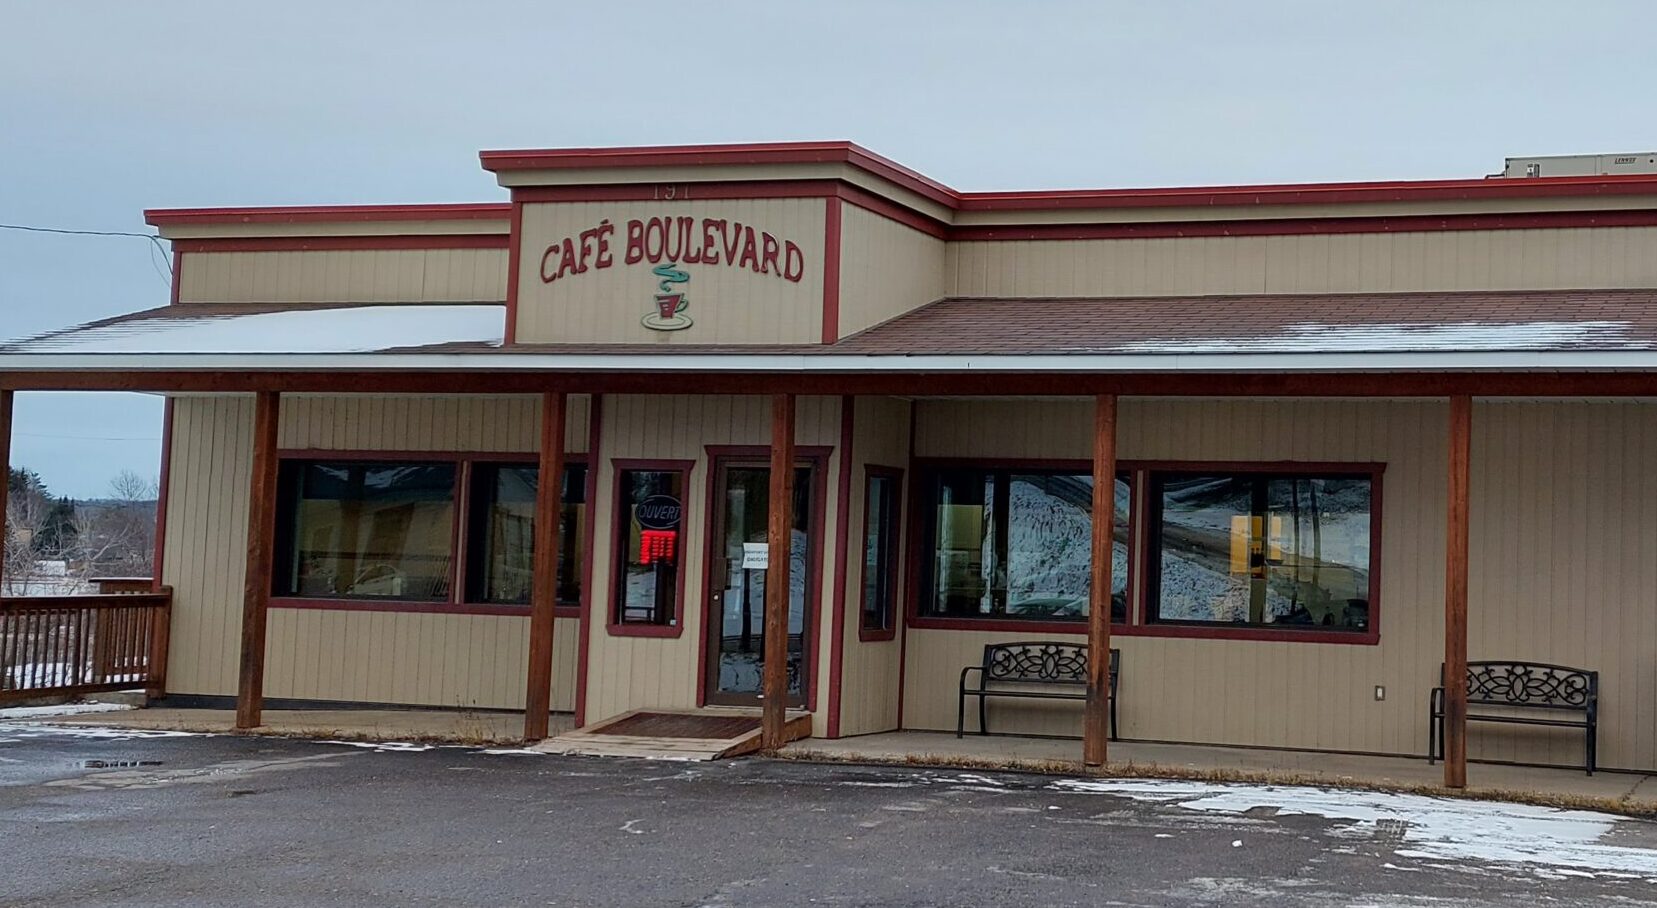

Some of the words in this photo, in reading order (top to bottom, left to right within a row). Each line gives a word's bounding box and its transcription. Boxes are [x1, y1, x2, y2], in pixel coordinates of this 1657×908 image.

[653, 183, 690, 200] 191
[540, 219, 614, 284] CAFÉ
[624, 216, 804, 283] BOULEVARD
[639, 504, 682, 520] OUVERT
